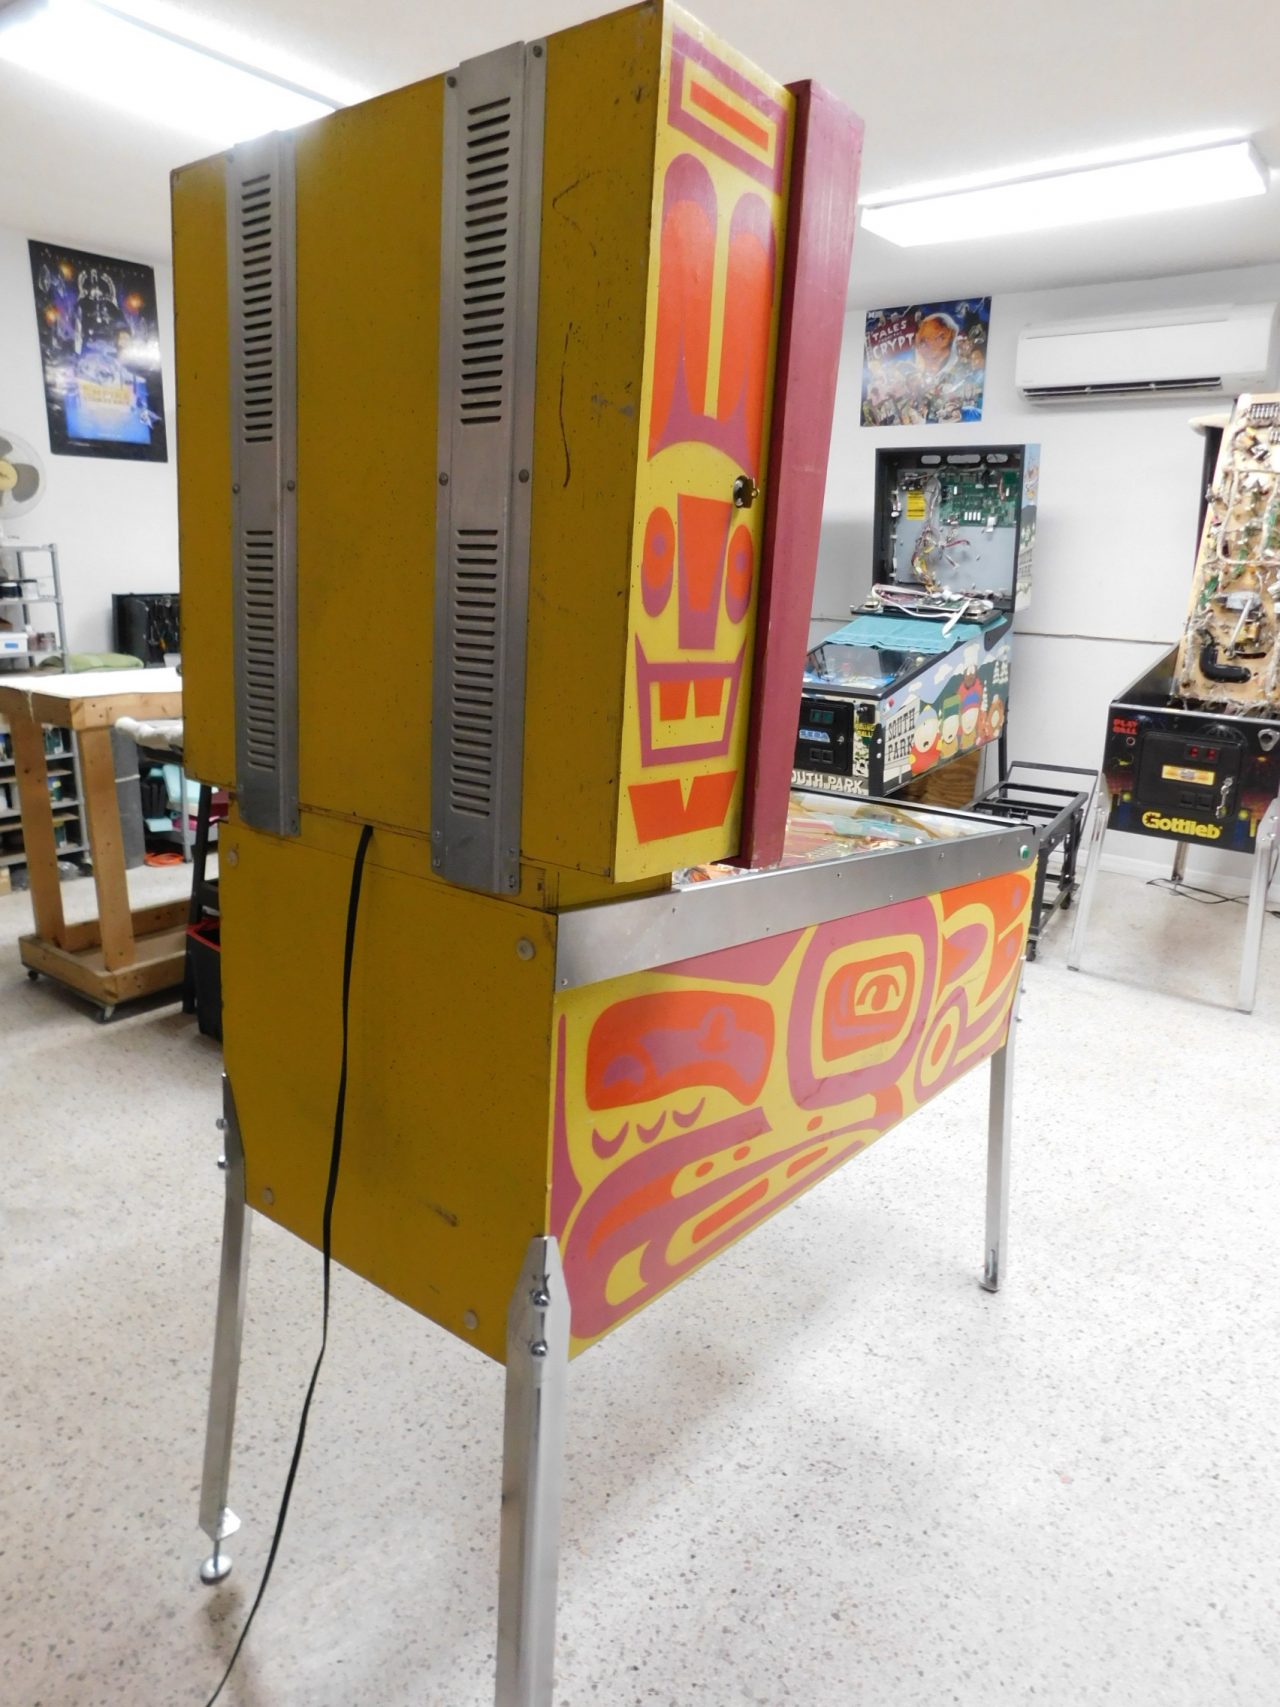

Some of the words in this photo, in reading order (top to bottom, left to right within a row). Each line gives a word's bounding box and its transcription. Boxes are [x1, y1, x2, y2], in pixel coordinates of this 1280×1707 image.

[872, 320, 908, 342] TALES
[872, 332, 915, 360] CRYPT
[888, 707, 915, 742] SOUTH
[887, 733, 915, 762] PARK
[790, 769, 824, 788] OUTH
[827, 775, 864, 794] PARK
[1142, 811, 1221, 839] Gottlieb
